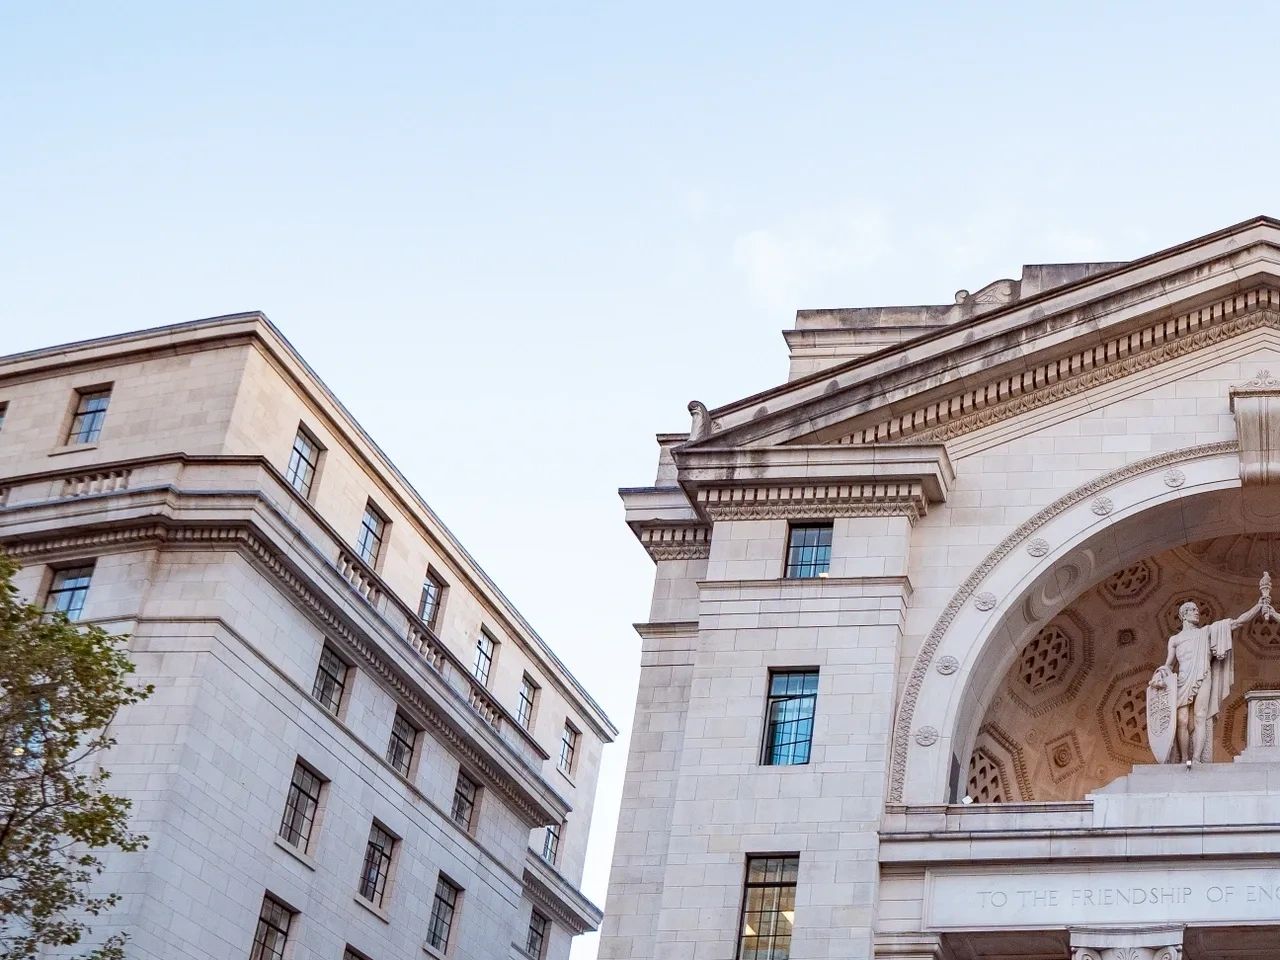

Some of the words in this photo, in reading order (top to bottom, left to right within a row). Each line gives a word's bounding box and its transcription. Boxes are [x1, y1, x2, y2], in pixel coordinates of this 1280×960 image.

[976, 891, 1008, 908] TO
[1016, 890, 1059, 908] THE
[1071, 887, 1192, 906] FRIENDSHIP
[1206, 886, 1235, 903] OF
